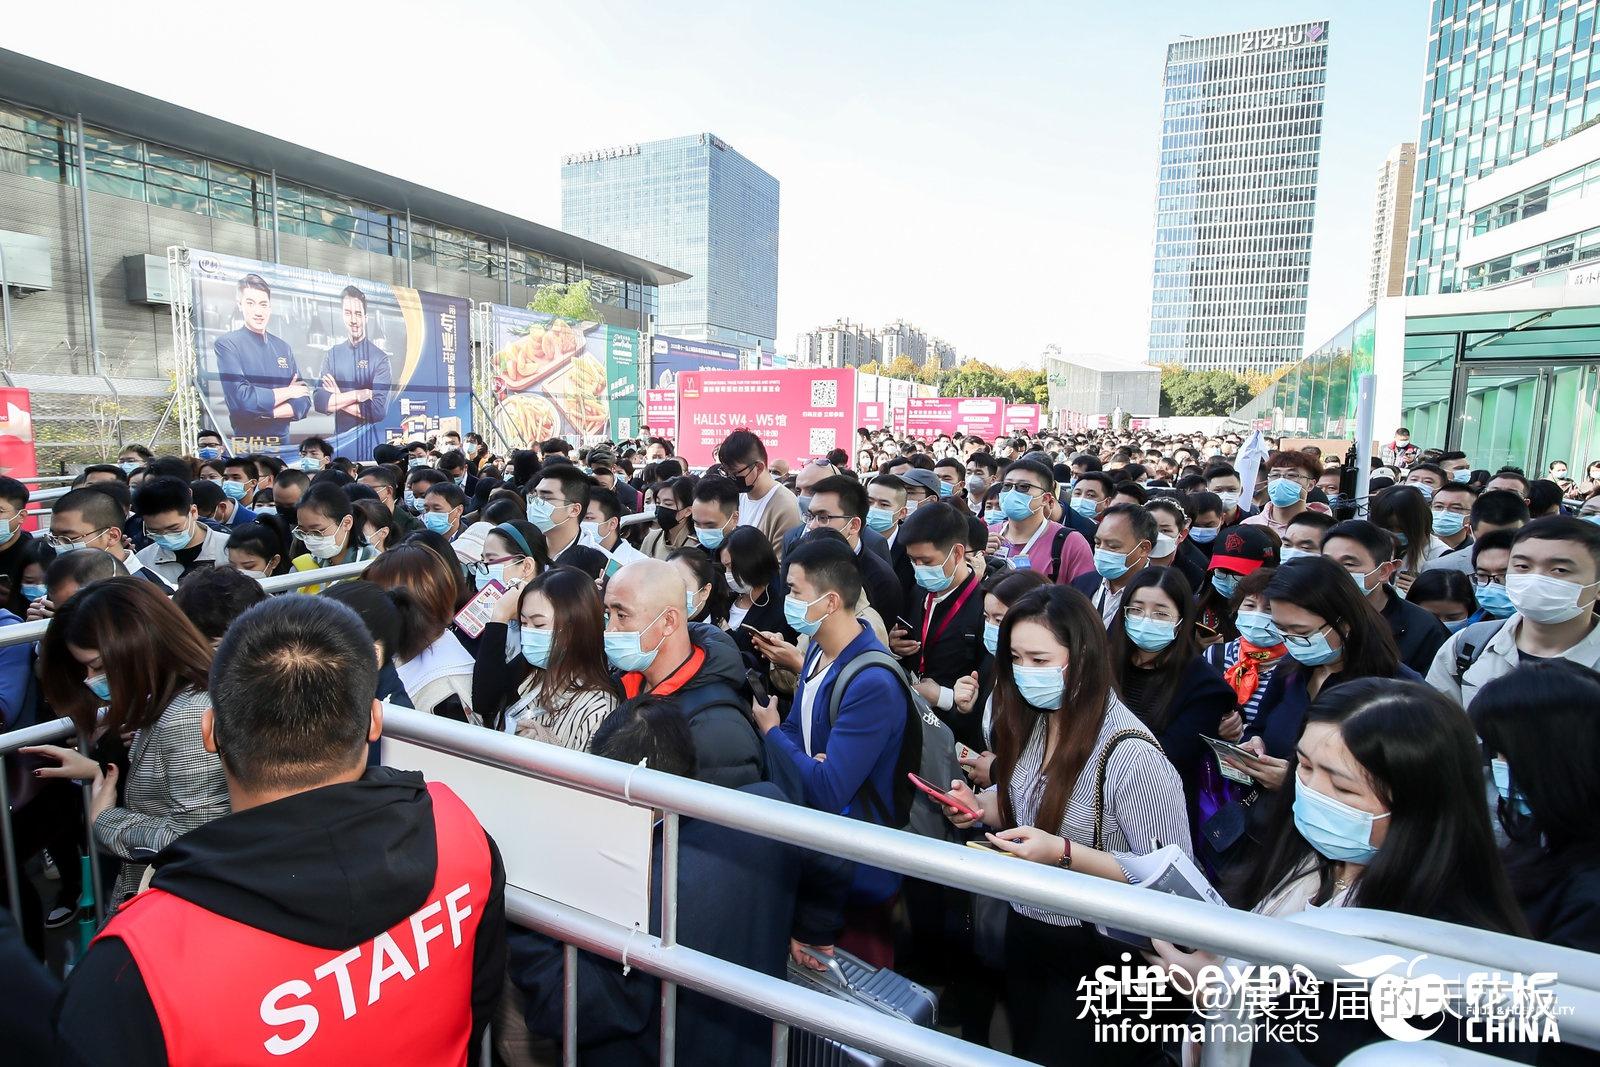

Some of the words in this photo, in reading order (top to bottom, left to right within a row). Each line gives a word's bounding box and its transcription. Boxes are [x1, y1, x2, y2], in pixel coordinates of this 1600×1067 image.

[1242, 31, 1303, 51] ZIZHU
[693, 413, 727, 425] HALLS
[728, 413, 747, 425] W4
[755, 413, 774, 426] W5
[259, 883, 473, 1056] STAFF
